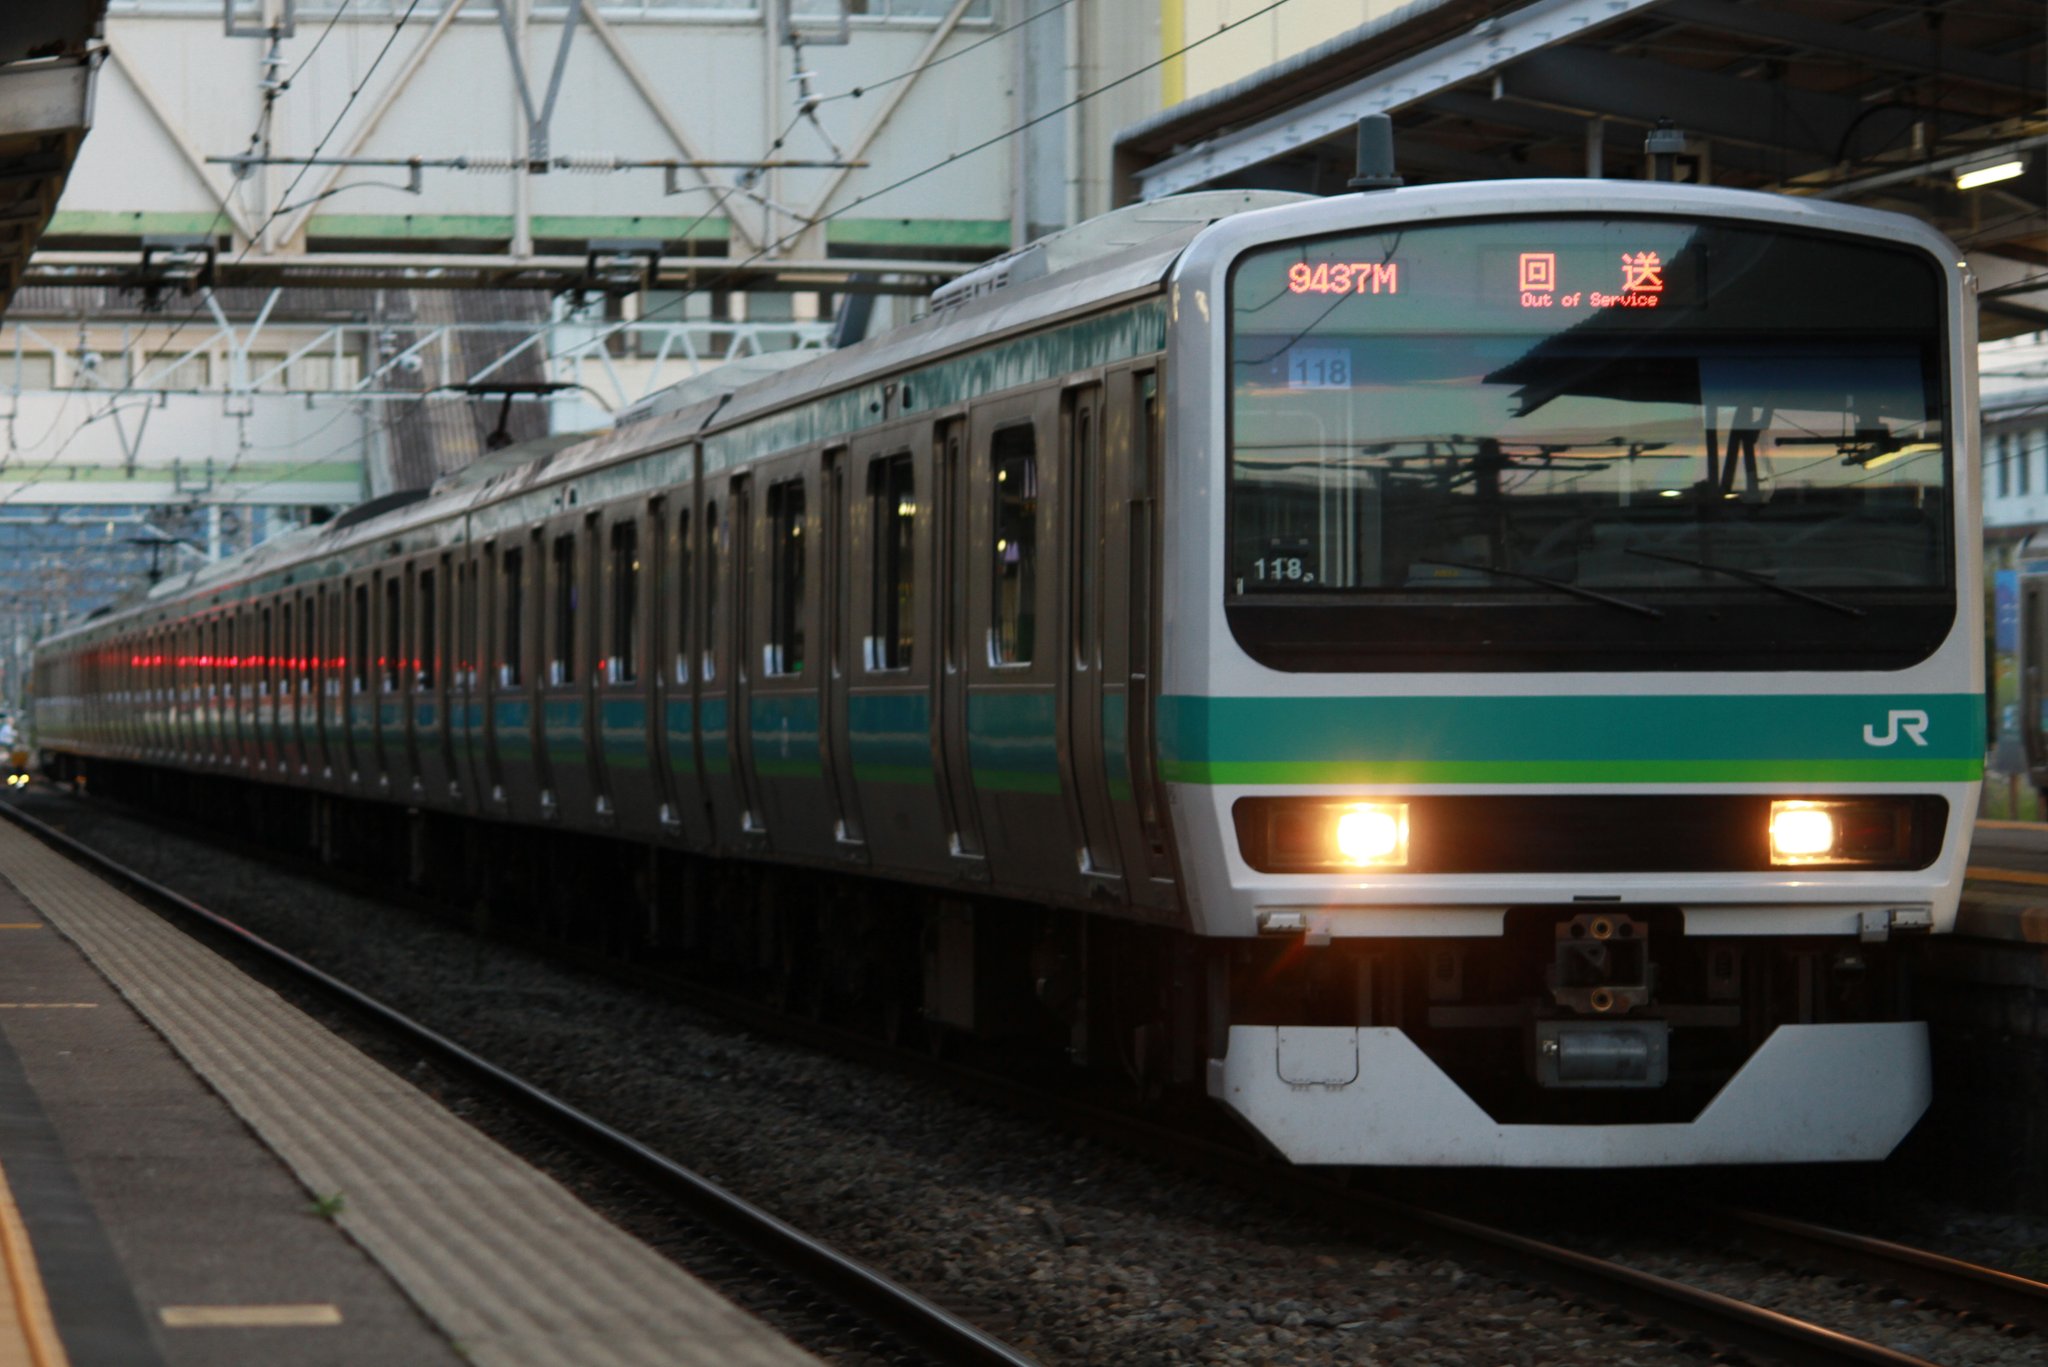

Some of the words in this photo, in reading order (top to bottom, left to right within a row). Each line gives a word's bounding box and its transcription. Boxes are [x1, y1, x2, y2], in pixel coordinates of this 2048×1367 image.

[1288, 262, 1398, 294] 9437M
[1520, 291, 1553, 308] Out
[1560, 291, 1582, 308] of
[1589, 291, 1658, 309] Service
[1295, 359, 1347, 386] 118
[1253, 557, 1303, 581] 118
[1863, 709, 1929, 747] JR
